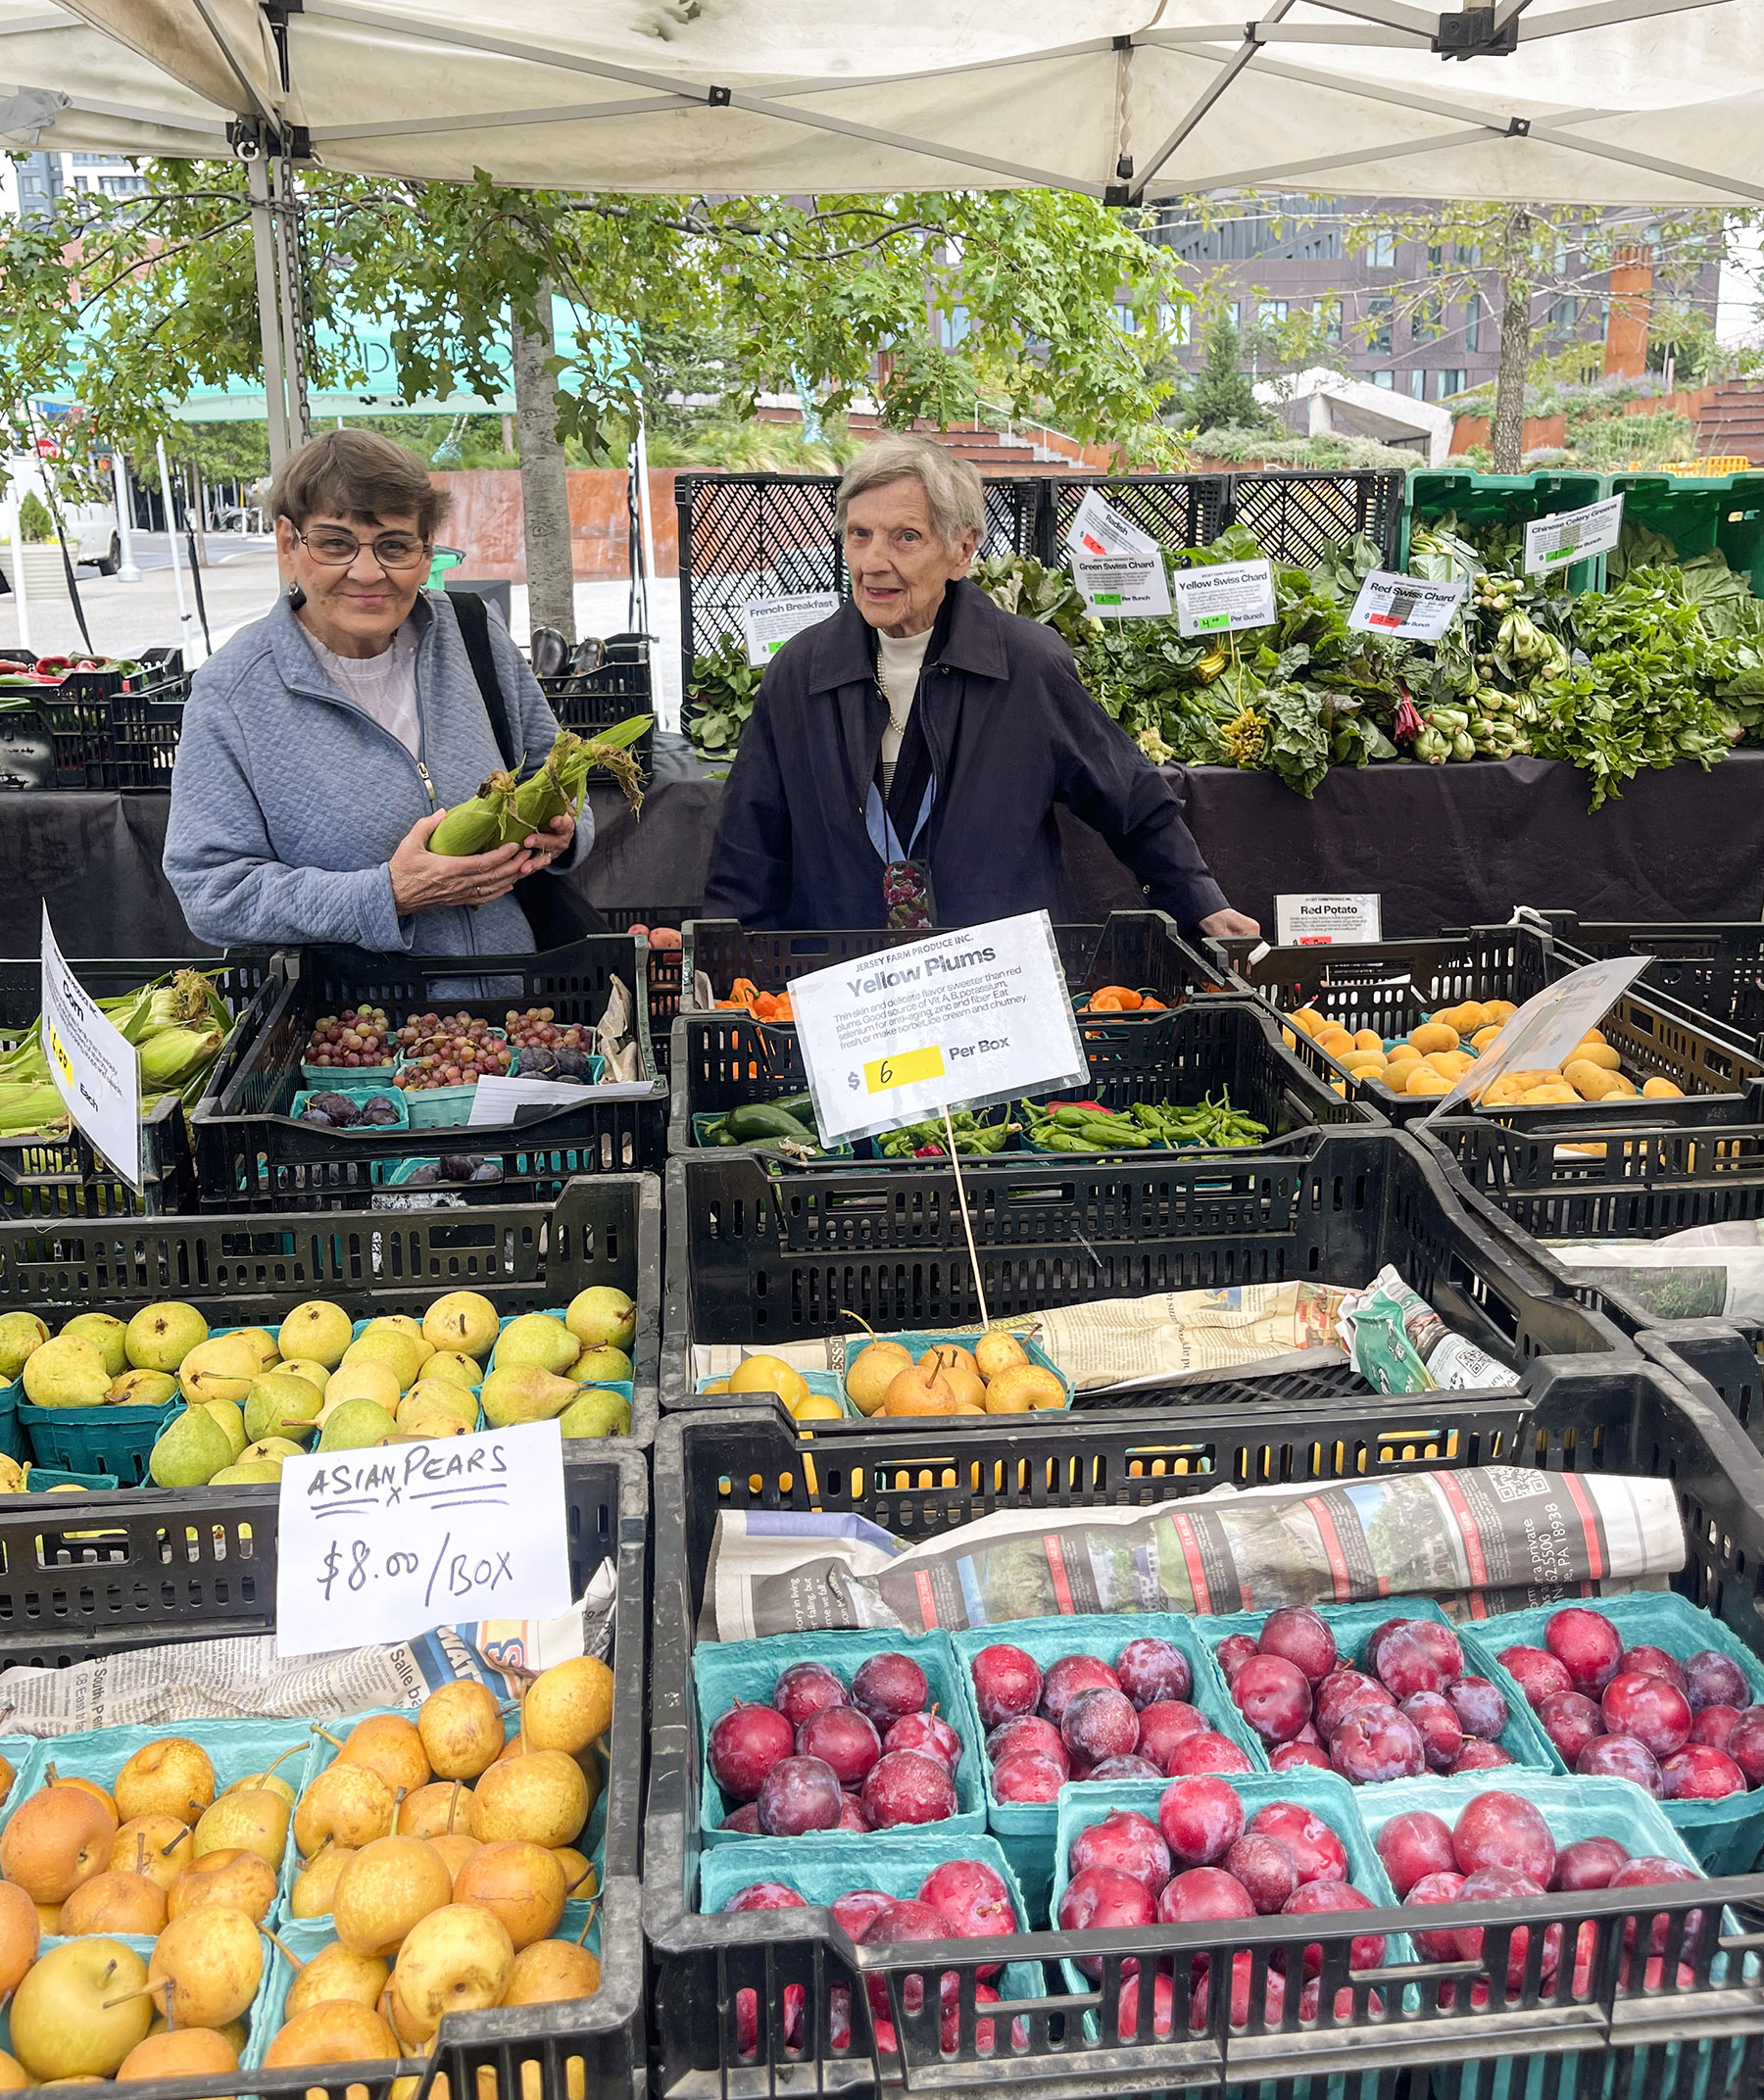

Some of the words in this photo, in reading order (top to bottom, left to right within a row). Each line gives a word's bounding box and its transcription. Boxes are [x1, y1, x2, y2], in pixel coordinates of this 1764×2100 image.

[1105, 514, 1128, 536] Radish
[1532, 522, 1564, 533] Chinese
[1566, 514, 1590, 526] Celery
[1591, 504, 1617, 516] Greens
[1128, 560, 1154, 568] Chard
[1179, 580, 1212, 591] Yellow
[1213, 576, 1240, 586] Swiss
[1241, 572, 1268, 582] Chard
[1370, 583, 1392, 593] Red
[1393, 588, 1423, 599] Swiss
[1424, 592, 1456, 602] Chard
[750, 606, 784, 617] French
[786, 600, 833, 611] Breakfast
[1300, 905, 1322, 914] Red
[1324, 905, 1357, 914] Potato
[856, 956, 885, 972] JERSEY
[886, 950, 911, 963] FARM
[912, 938, 954, 955] PRODUCE
[955, 934, 974, 945] INC.
[847, 966, 921, 998] Yellow
[924, 948, 997, 977] Plums
[64, 979, 84, 1021] Corn
[834, 1012, 852, 1023] Thin
[853, 1007, 869, 1017] skin
[870, 1001, 887, 1012] and
[887, 993, 921, 1007] delicate
[921, 986, 945, 998] flavor
[947, 976, 983, 992] sweeter
[984, 971, 1005, 982] than
[1006, 965, 1022, 976] red
[838, 1024, 875, 1041] selenium
[875, 1021, 888, 1030] for
[934, 1003, 953, 1014] zinc
[953, 998, 970, 1009] and
[993, 989, 1009, 1000] Eat
[862, 1010, 887, 1024] Good
[887, 1003, 917, 1017] source
[918, 998, 927, 1008] of
[928, 996, 941, 1005] Vit
[872, 1028, 897, 1039] make
[928, 1016, 942, 1026] ice
[942, 1008, 971, 1022] cream
[971, 1002, 990, 1013] and
[847, 1071, 861, 1091] $
[880, 1060, 894, 1085] 6
[949, 1043, 976, 1061] Per
[978, 1036, 1010, 1054] Box
[80, 1083, 99, 1112] Each
[307, 1465, 396, 1496] ASIAN
[404, 1445, 508, 1487] PEARS
[1544, 1502, 1567, 1542] 18938
[1524, 1518, 1544, 1563] private
[1539, 1534, 1558, 1584] 62.5500
[1557, 1546, 1571, 1566] PA
[786, 1578, 800, 1598] living
[804, 1578, 812, 1591] but
[793, 1599, 802, 1608] in
[807, 1592, 817, 1619] falling,
[822, 1596, 829, 1607] we
[824, 1608, 833, 1628] ime
[840, 1608, 850, 1626] son
[390, 1648, 415, 1686] Salle
[437, 1627, 484, 1685] WAT
[76, 1674, 88, 1685] CB
[90, 1668, 108, 1705] South,
[75, 1686, 87, 1712] East
